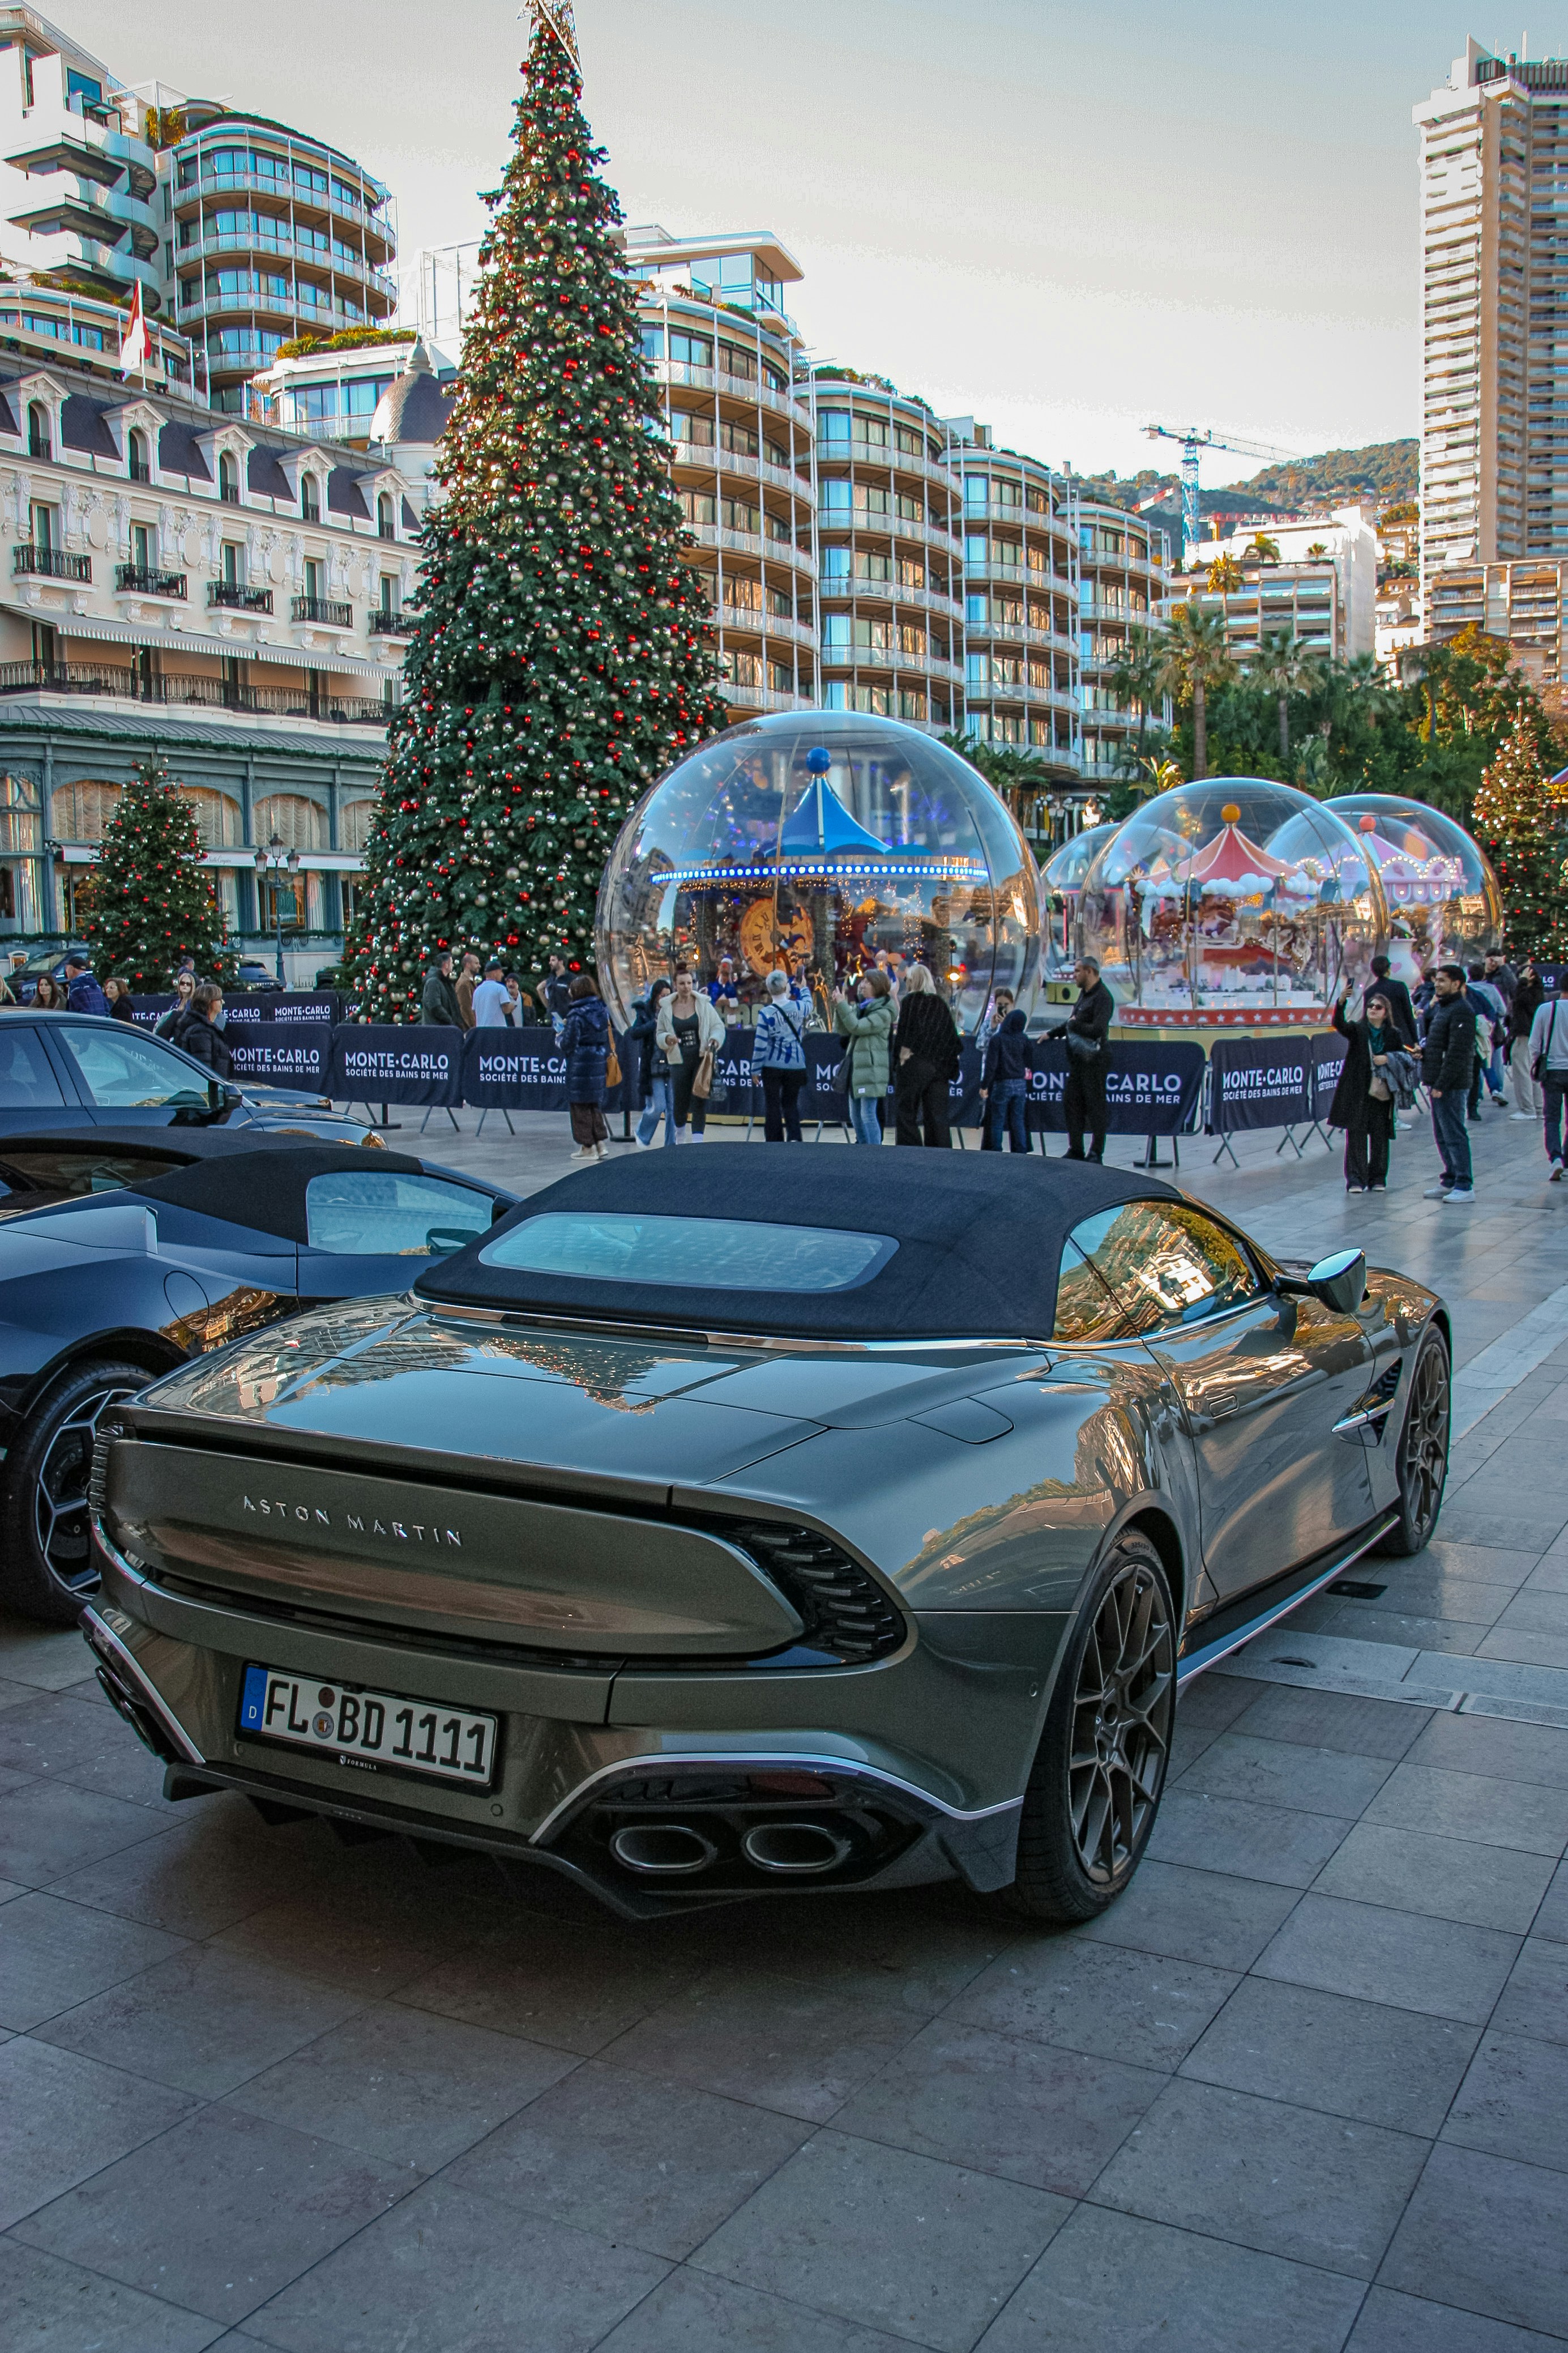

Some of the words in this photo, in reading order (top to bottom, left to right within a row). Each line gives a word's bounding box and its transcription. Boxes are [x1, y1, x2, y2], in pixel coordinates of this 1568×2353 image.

[221, 1008, 260, 1018] E·CARLO
[275, 1005, 330, 1016] MONTE·CARLO
[345, 1052, 448, 1070] MONTE·CARLO
[480, 1055, 567, 1074] MONTE·CA
[346, 1067, 377, 1077] SOCIÉTÉ
[379, 1069, 394, 1077] DES
[396, 1070, 418, 1079] BAINS
[421, 1071, 430, 1079] DE
[433, 1071, 448, 1080] MER
[480, 1072, 518, 1082] SOCIÉTÉ
[521, 1075, 537, 1083] DES
[1223, 1065, 1303, 1089] MONTE·CARLO
[740, 1078, 752, 1087] DE
[949, 1086, 963, 1097] ER
[1247, 1089, 1261, 1099] DES
[1262, 1087, 1280, 1098] BAINS
[1281, 1086, 1289, 1095] DE
[1135, 1094, 1151, 1103] DE
[1156, 1094, 1181, 1104] MER
[243, 1495, 330, 1525] ASTON
[347, 1514, 462, 1546] MARTIN
[249, 1706, 257, 1719] D
[265, 1679, 309, 1734] FL
[337, 1695, 386, 1750] BD
[392, 1708, 486, 1775] 1111
[347, 1759, 377, 1771] FORMULA
